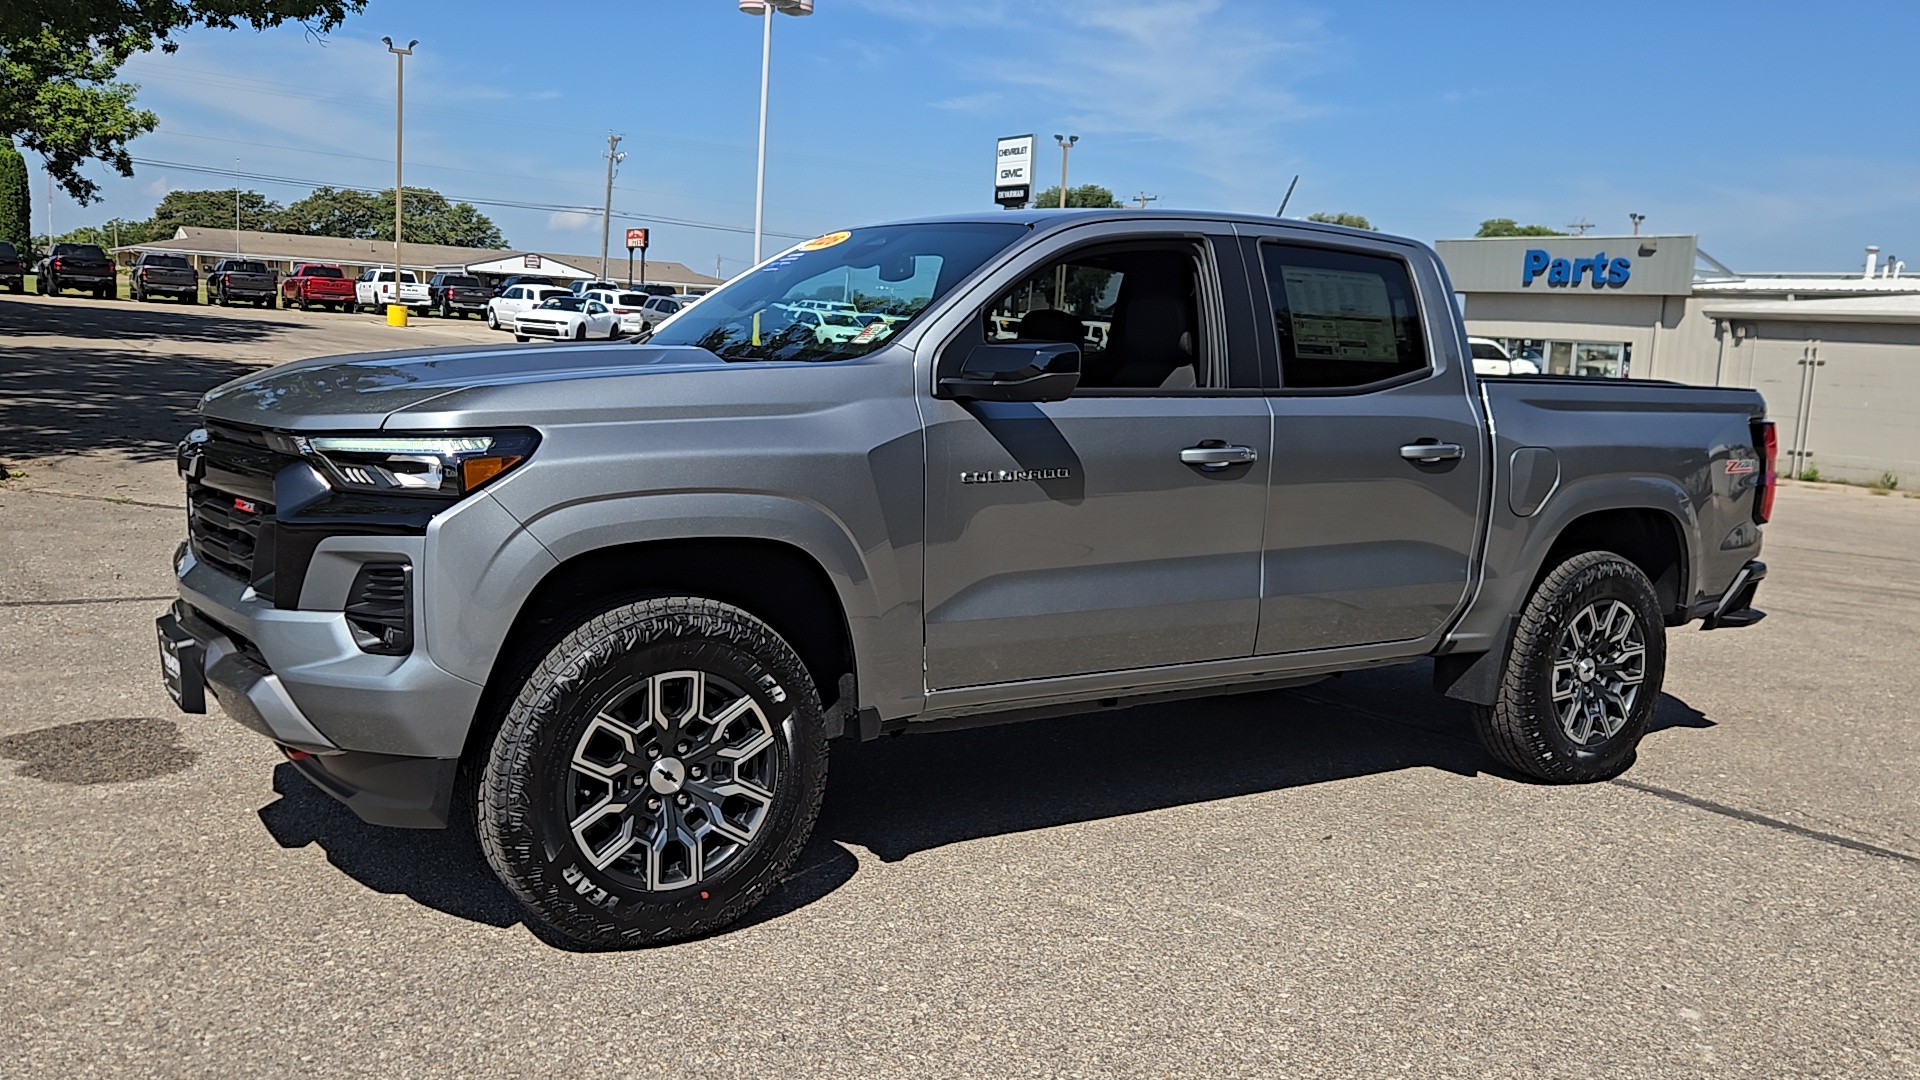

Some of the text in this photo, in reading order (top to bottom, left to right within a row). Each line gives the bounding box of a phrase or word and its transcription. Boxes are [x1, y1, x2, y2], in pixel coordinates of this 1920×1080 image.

[999, 146, 1027, 157] CHEVROLET
[1001, 168, 1023, 179] GMC
[1522, 249, 1631, 287] Parts
[961, 469, 1070, 483] COLORADO
